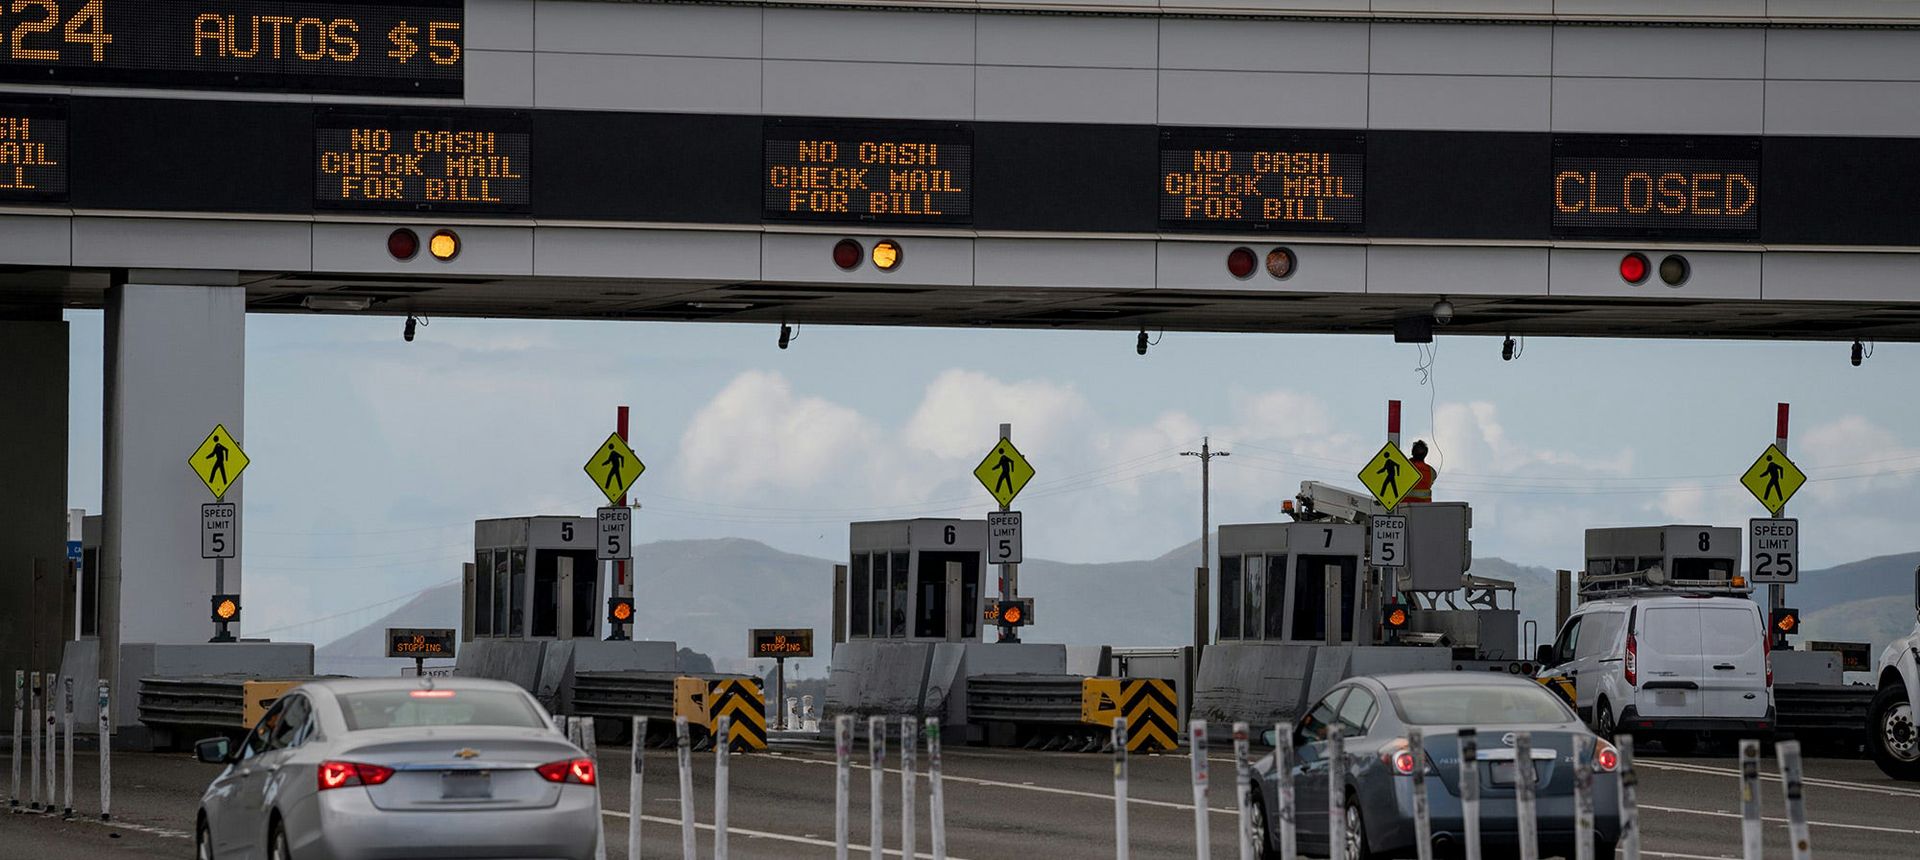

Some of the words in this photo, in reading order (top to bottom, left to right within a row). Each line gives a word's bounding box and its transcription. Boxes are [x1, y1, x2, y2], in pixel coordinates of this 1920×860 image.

[194, 13, 359, 61] AUTOS
[388, 20, 460, 65] $5
[351, 128, 391, 150] NO
[414, 130, 495, 153] CASH
[799, 140, 837, 162] NO
[859, 142, 937, 165] CASH
[1194, 150, 1232, 172] NO
[1253, 151, 1330, 174] CASH
[321, 151, 424, 175] CHECK
[446, 155, 521, 178] MAIL
[342, 176, 403, 199] FOR
[425, 178, 500, 201] BILL
[770, 166, 868, 189] CHECK
[890, 169, 962, 192] MAIL
[1165, 173, 1262, 196] CHECK
[1283, 175, 1354, 198] MAIL
[790, 190, 848, 212] FOR
[869, 192, 942, 215] BILL
[1556, 171, 1755, 215] CLOSED
[1184, 197, 1242, 218] FOR
[1263, 198, 1334, 221] BILL
[204, 509, 233, 518] SPEED
[599, 512, 629, 521] SPEED
[990, 517, 1019, 526] SPEED
[207, 520, 229, 529] LIMIT
[561, 521, 574, 542] 5
[602, 523, 625, 532] LIMIT
[993, 528, 1016, 537] LIMIT
[1374, 520, 1404, 529] SPEED
[1754, 525, 1794, 536] SPEED
[212, 533, 225, 553] 5
[607, 535, 620, 555] 5
[944, 525, 956, 545] 6
[1323, 528, 1333, 548] 7
[1377, 531, 1400, 540] LIMIT
[1698, 531, 1710, 552] 8
[1758, 539, 1789, 549] LIMIT
[999, 540, 1012, 559] 5
[1382, 542, 1395, 562] 5
[1755, 552, 1793, 576] 25
[397, 643, 442, 652] STOPPING
[413, 634, 425, 643] NO
[760, 643, 801, 652] STOPPING
[775, 635, 786, 644] NO
